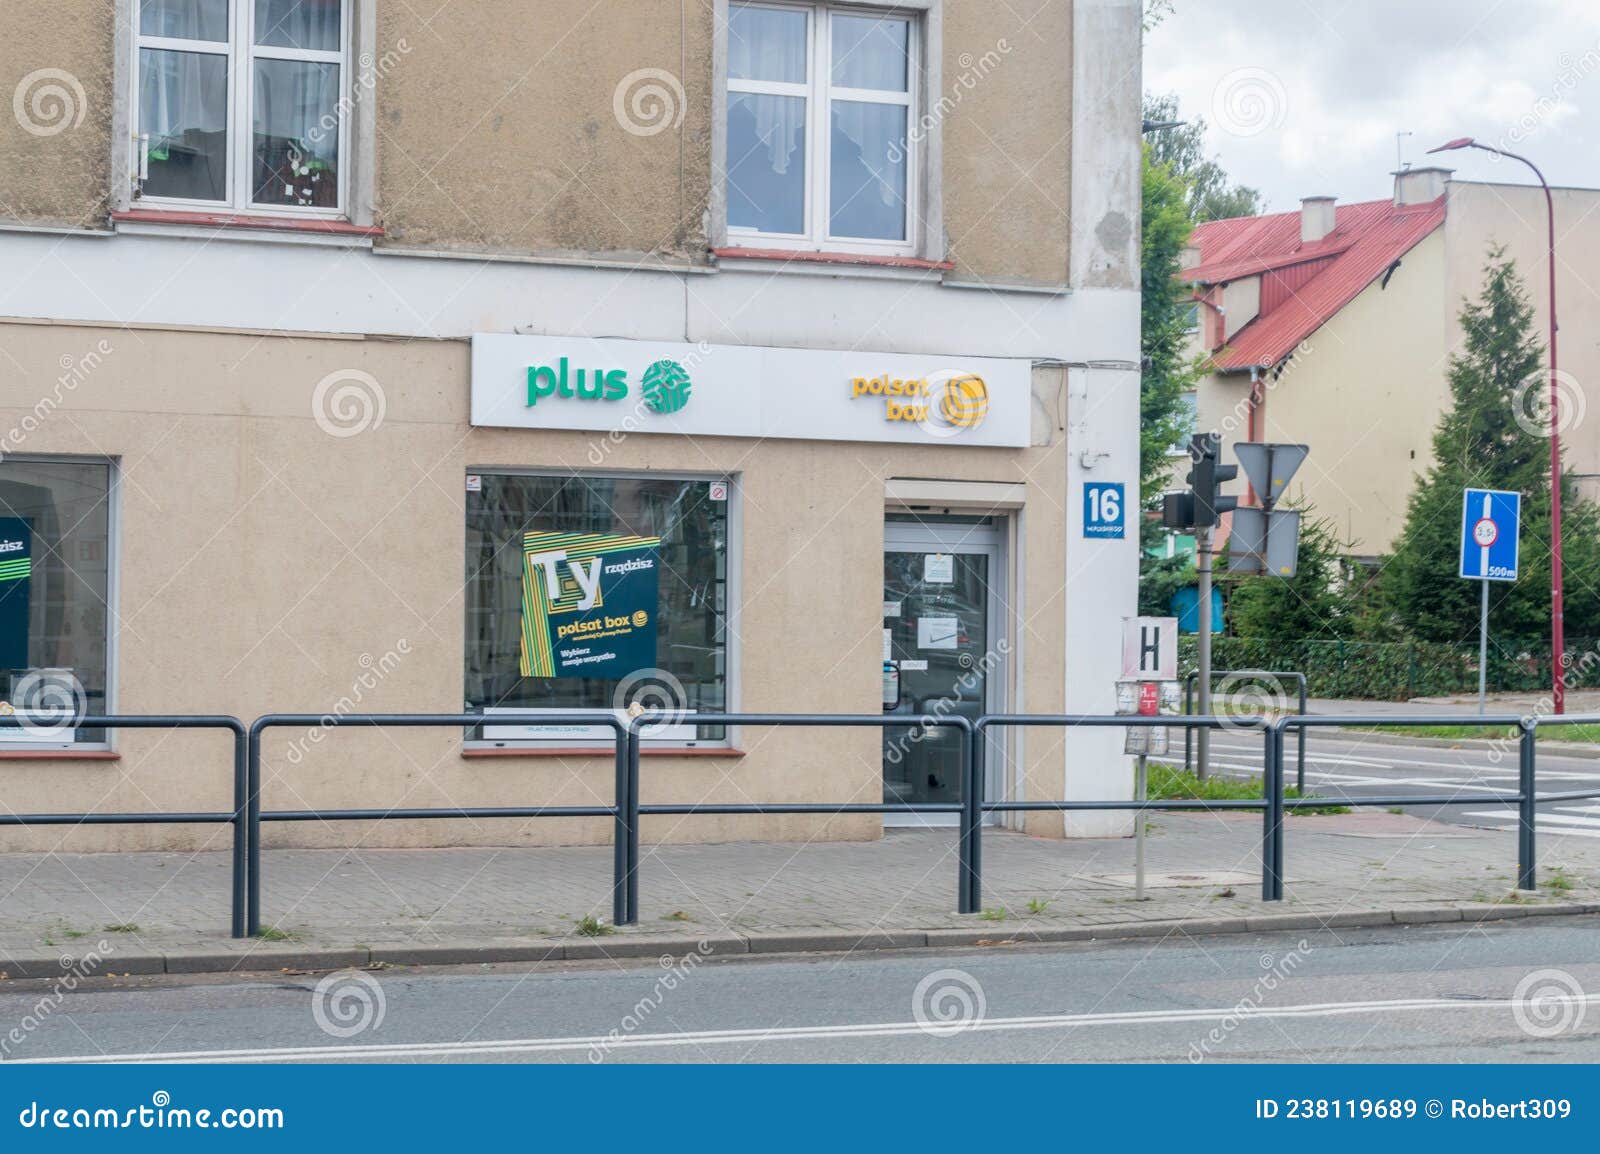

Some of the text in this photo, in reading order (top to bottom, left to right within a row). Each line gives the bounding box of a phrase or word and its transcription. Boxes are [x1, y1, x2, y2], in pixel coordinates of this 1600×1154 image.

[527, 356, 629, 407] plus
[852, 374, 930, 399] polsat
[886, 398, 929, 421] box
[1089, 488, 1120, 522] 16
[530, 550, 653, 611] Ty rządzisz
[1488, 566, 1516, 577] 500m
[557, 616, 630, 638] polsat box
[1139, 626, 1160, 671] H
